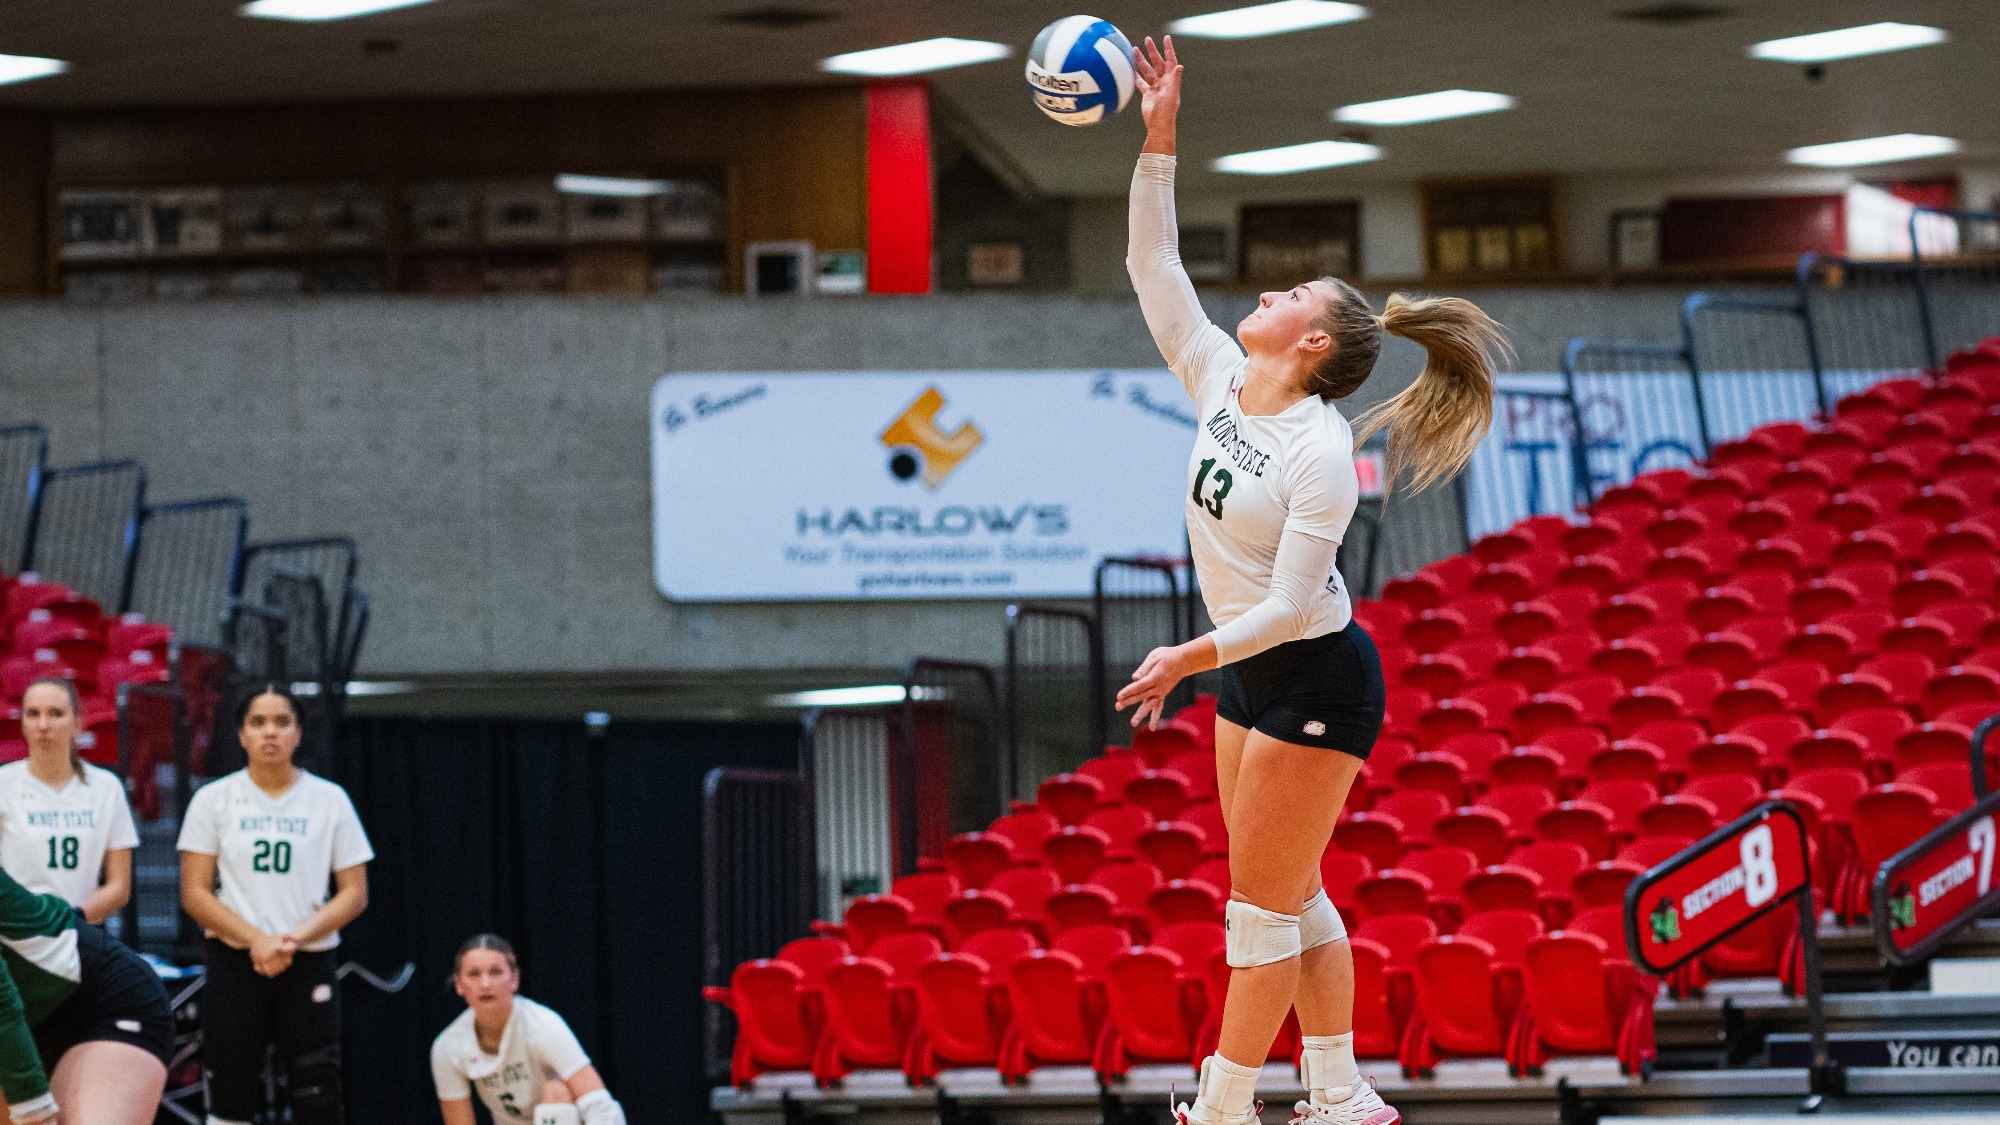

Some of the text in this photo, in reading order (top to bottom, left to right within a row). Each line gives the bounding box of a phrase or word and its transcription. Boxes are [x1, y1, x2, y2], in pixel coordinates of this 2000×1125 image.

[1031, 71, 1080, 92] molten
[1206, 408, 1271, 477] MINOT STATE
[1191, 457, 1233, 521] 13
[63, 810, 94, 829] STATE
[47, 834, 79, 869] 18
[253, 840, 291, 874] 20
[1919, 854, 1975, 907] SECTION
[1968, 816, 1996, 898] 7
[1682, 823, 1778, 920] SECTION 8
[1886, 1041, 2000, 1067] You can
